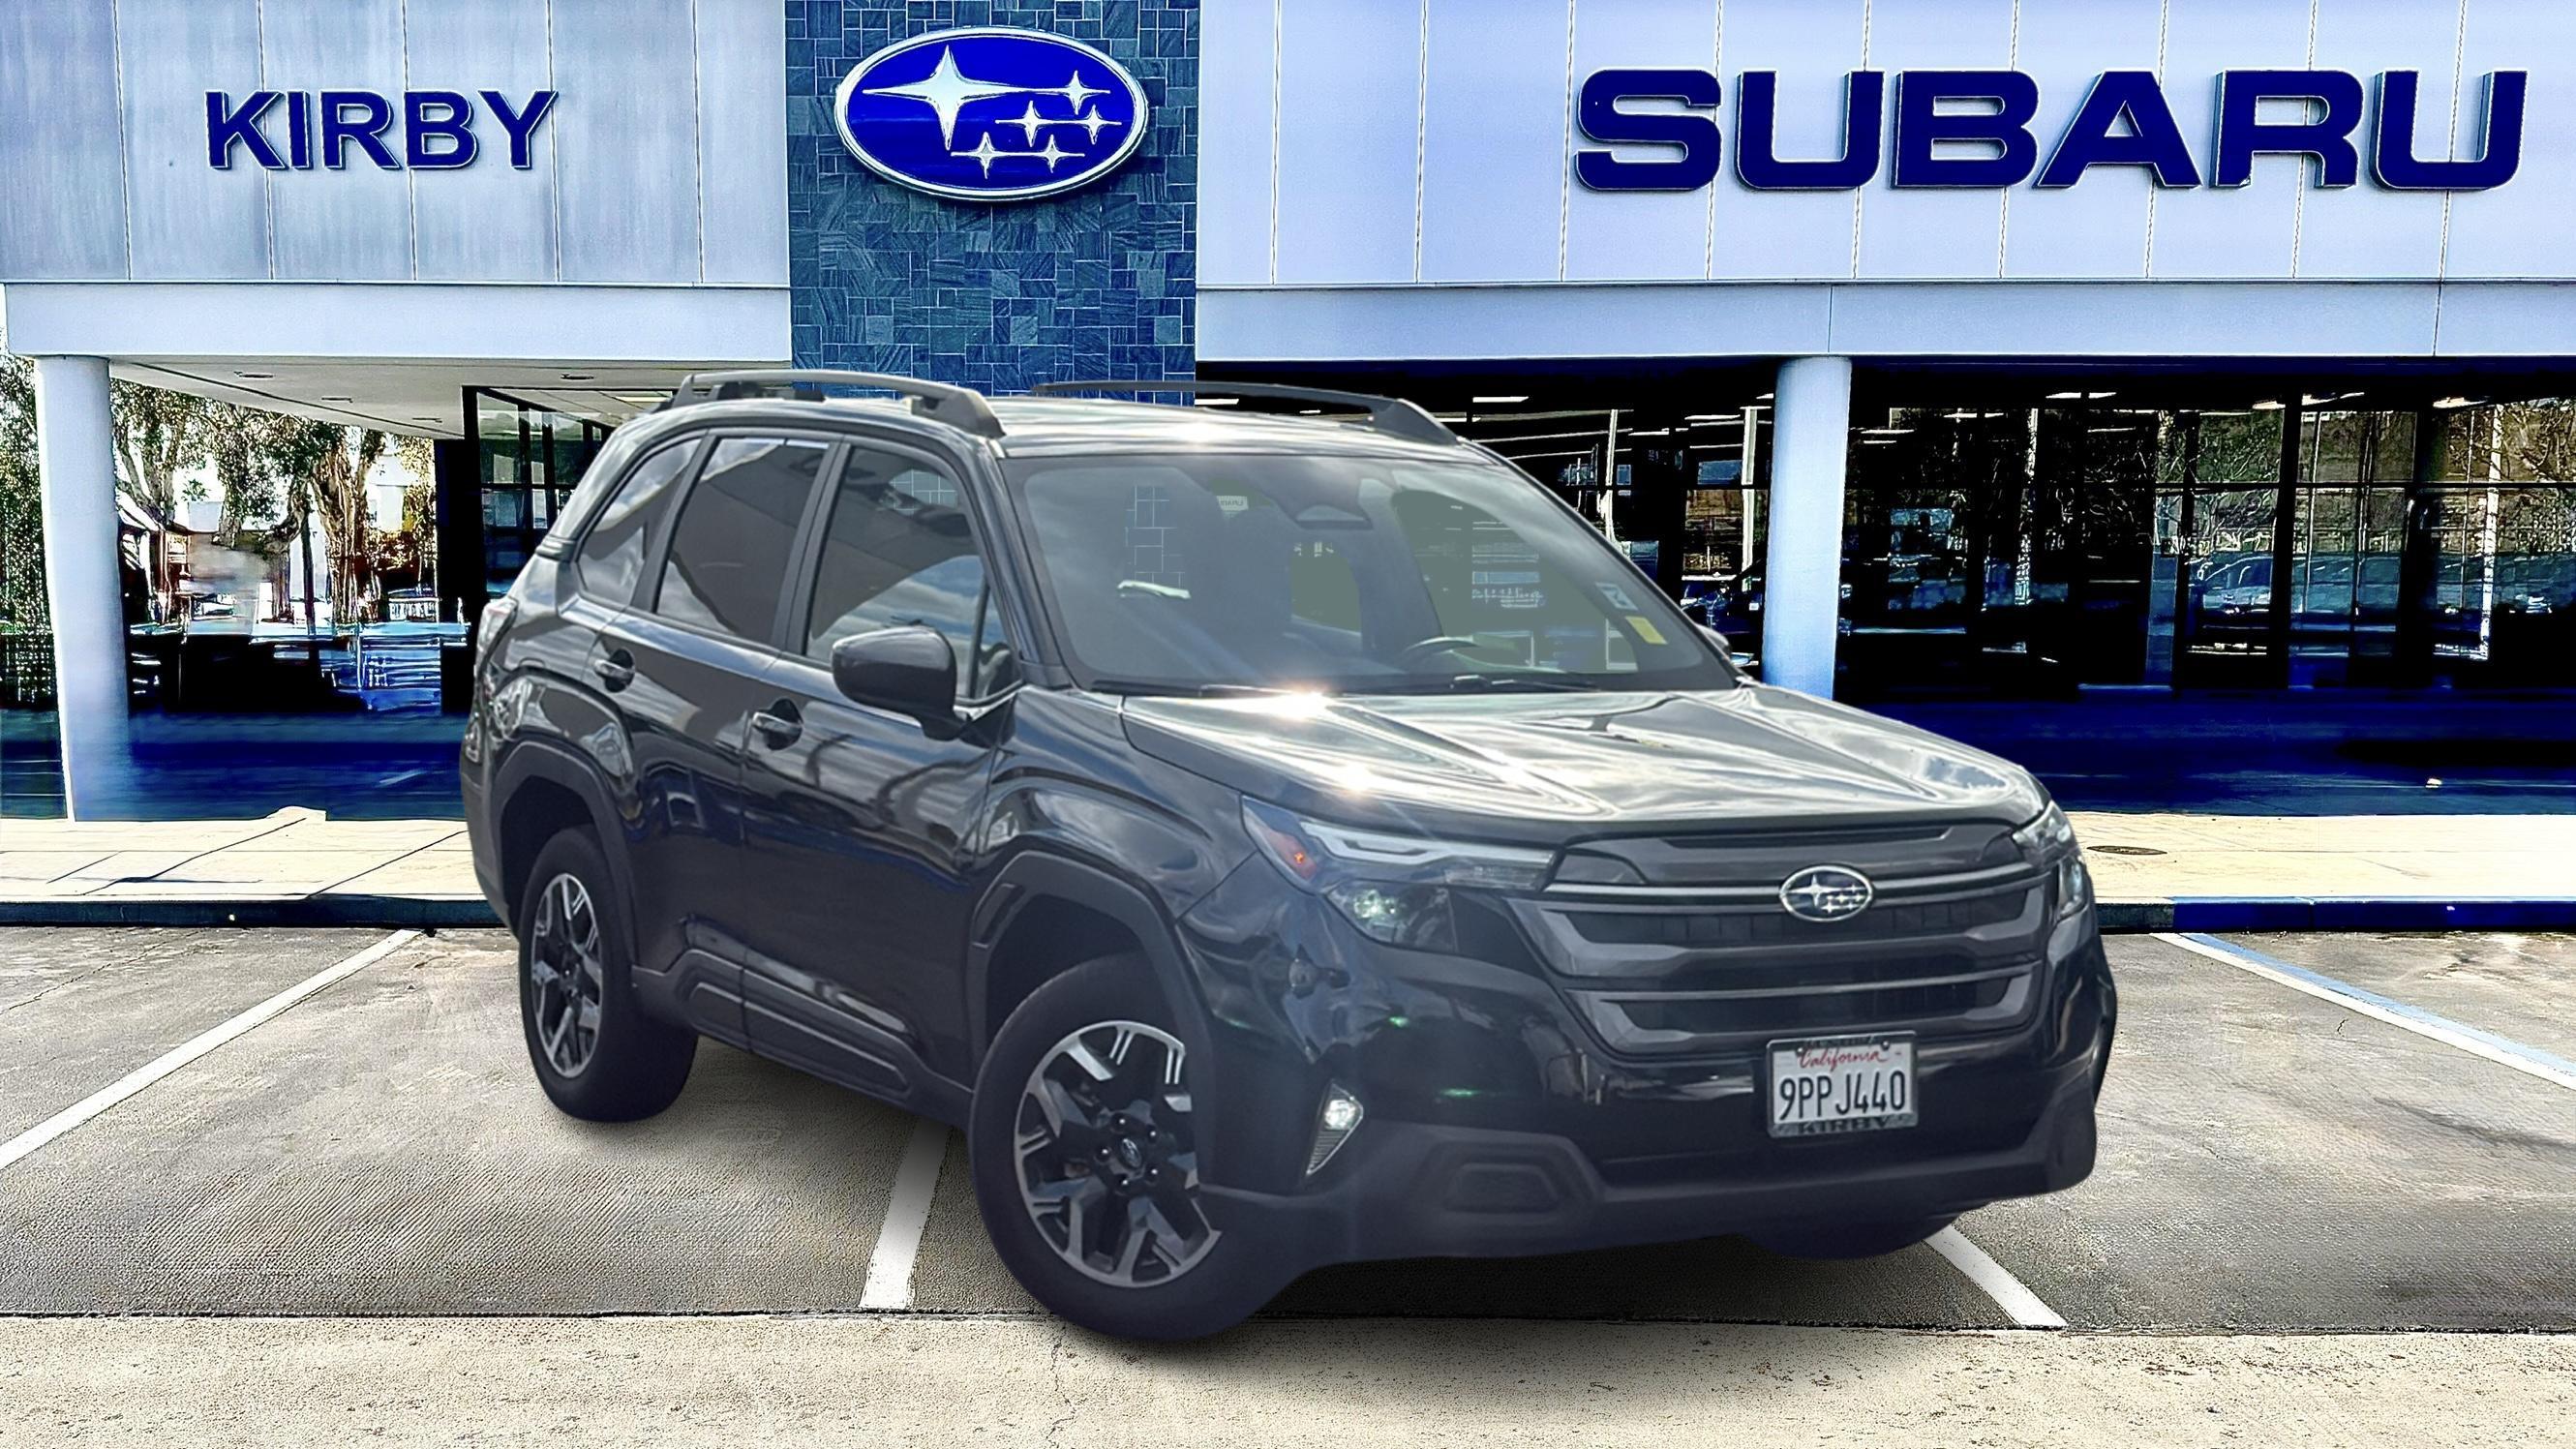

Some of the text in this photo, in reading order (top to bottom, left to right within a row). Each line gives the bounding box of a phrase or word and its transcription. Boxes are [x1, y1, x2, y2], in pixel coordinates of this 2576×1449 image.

[204, 89, 560, 170] KIRBY
[1575, 69, 2529, 191] SUBARU
[1799, 1048, 1888, 1072] California
[1779, 1070, 1906, 1121] 9PPJ440
[1798, 1115, 1888, 1133] KIRBY
